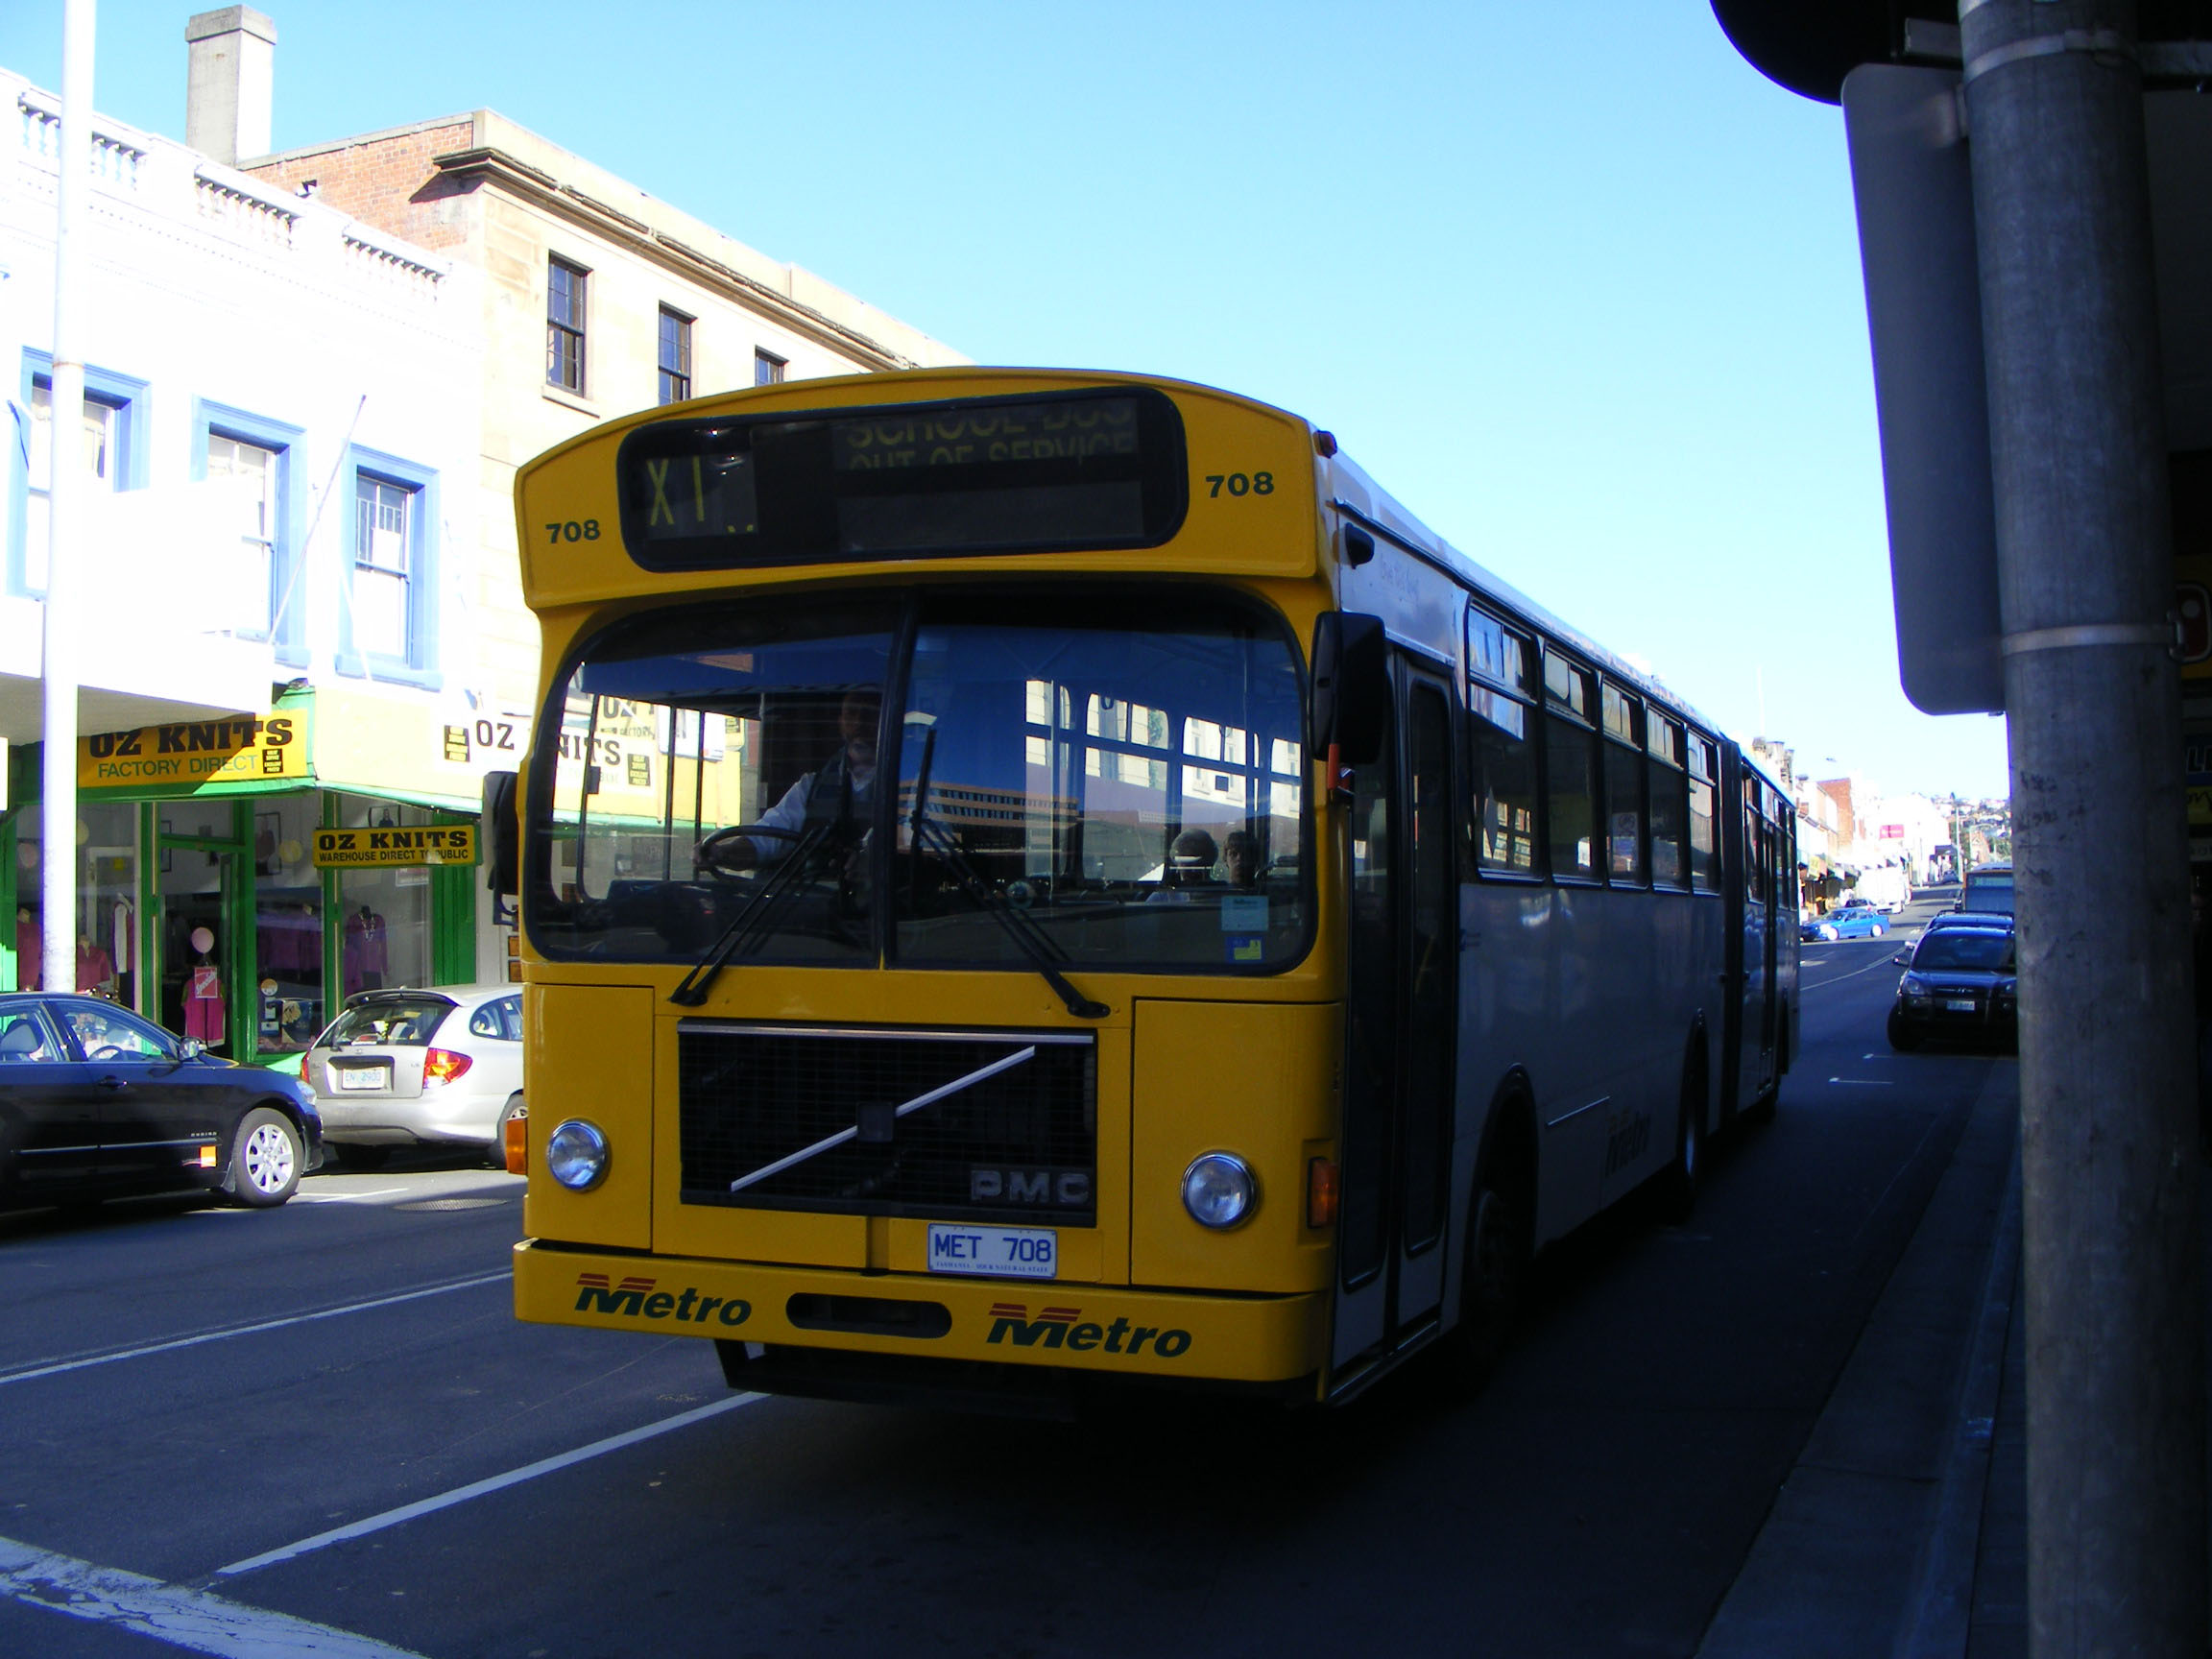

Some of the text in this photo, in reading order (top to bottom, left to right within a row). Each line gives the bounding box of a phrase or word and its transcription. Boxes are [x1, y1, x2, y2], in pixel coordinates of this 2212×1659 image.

[1206, 471, 1274, 498] 708
[545, 519, 601, 545] 708
[89, 718, 293, 758] OZ KNITS
[476, 719, 516, 751] OZ
[98, 755, 258, 779] FACTORY DIRECT
[319, 830, 469, 851] OZ KNITS
[319, 851, 376, 862] WAREHOUSE
[380, 850, 416, 860] DIRECT
[971, 1169, 1090, 1205] PMC
[935, 1234, 1052, 1262] MET 708
[574, 1272, 753, 1327] Metro
[986, 1302, 1192, 1358] Metro
